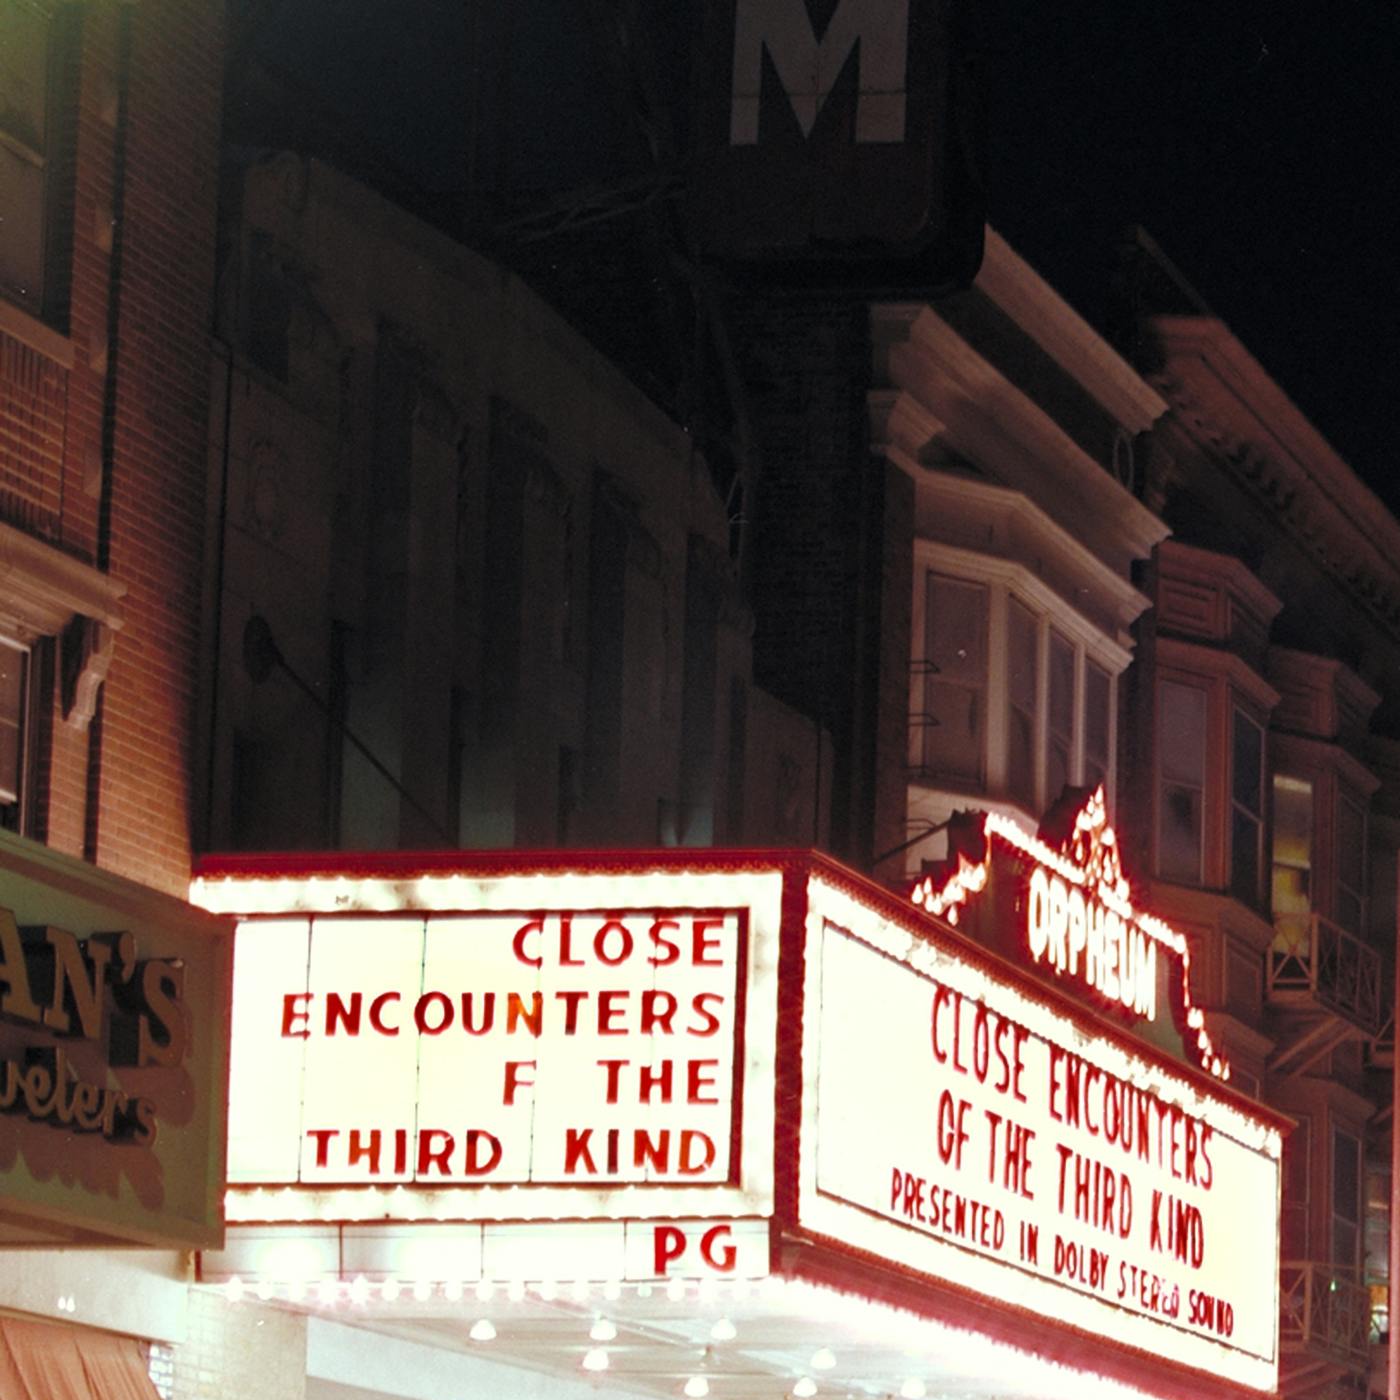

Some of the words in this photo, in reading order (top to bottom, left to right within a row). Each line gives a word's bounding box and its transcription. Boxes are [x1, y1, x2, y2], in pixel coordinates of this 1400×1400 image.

[512, 919, 724, 968] CLOSE
[1028, 866, 1157, 1021] ORPHEUM
[281, 990, 725, 1038] ENCOUNTERS
[503, 1059, 537, 1106] F
[597, 1059, 720, 1105] THE
[931, 984, 1029, 1103] CLOSE
[1049, 1042, 1214, 1191] ENCOUNTERS
[307, 1128, 503, 1176] THIRD
[564, 1128, 717, 1175] KIND
[984, 1109, 1036, 1201] THE
[1056, 1143, 1133, 1240] THIRD
[1150, 1189, 1205, 1269] KIND
[653, 1225, 738, 1275] PG
[891, 1166, 1005, 1251] PRESENTED
[1020, 1220, 1039, 1266] IN
[1054, 1234, 1109, 1291] DOLBY
[1188, 1289, 1234, 1338] SOUND
